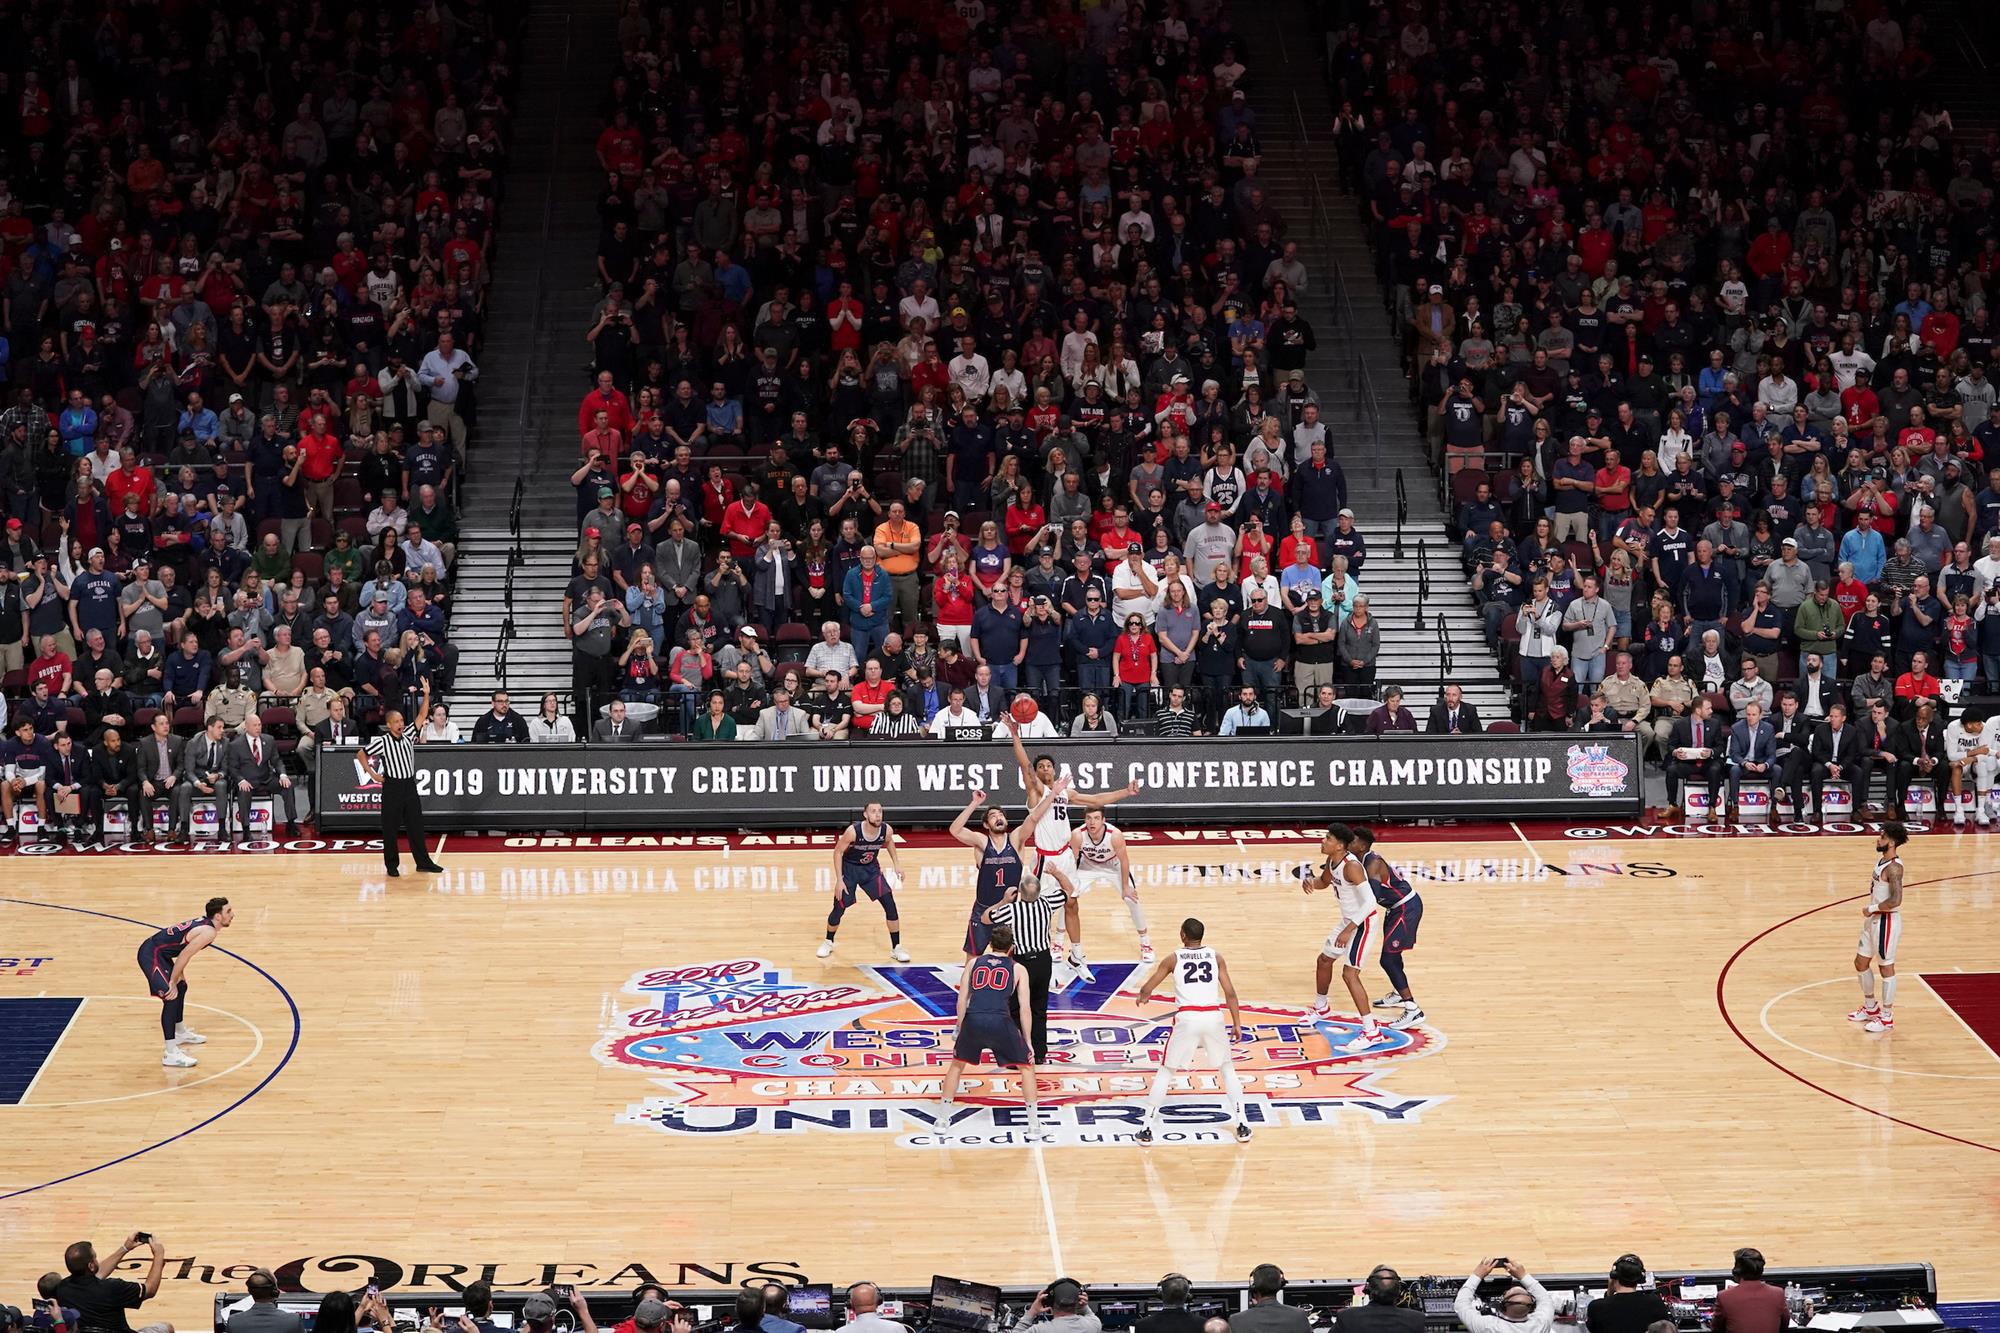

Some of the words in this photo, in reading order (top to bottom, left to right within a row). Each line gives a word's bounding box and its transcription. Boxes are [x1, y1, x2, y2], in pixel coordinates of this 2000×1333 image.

[377, 292, 387, 301] 15
[1216, 492, 1234, 505] 25
[1672, 550, 1680, 562] 1
[955, 728, 983, 738] POSS
[1957, 737, 1980, 747] FAMILY
[415, 768, 484, 796] 2019
[498, 767, 678, 795] UNIVERSITY
[692, 765, 798, 794] CREDIT
[813, 764, 902, 792] UNION
[917, 763, 1003, 792] WEST
[1127, 759, 1316, 789] CONFERENCE
[1328, 758, 1552, 787] CHAMPIONSHIP
[338, 793, 370, 803] WEST
[1053, 805, 1067, 821] 15
[504, 835, 728, 847] ORLEANS
[1163, 829, 1331, 841] VEGAS
[1563, 821, 1931, 839] @WCCHOOS
[17, 839, 385, 855] @WCCHOOPS
[994, 868, 1006, 888] 1
[1179, 952, 1203, 961] NORVELL
[638, 960, 761, 986] 2019
[971, 965, 1011, 990] 00
[1183, 961, 1213, 985] 23
[719, 987, 862, 1013] Vegas
[660, 1098, 1430, 1133] UNIVERSITY
[1080, 1130, 1221, 1144] unon
[274, 1254, 808, 1293] ORLEANS
